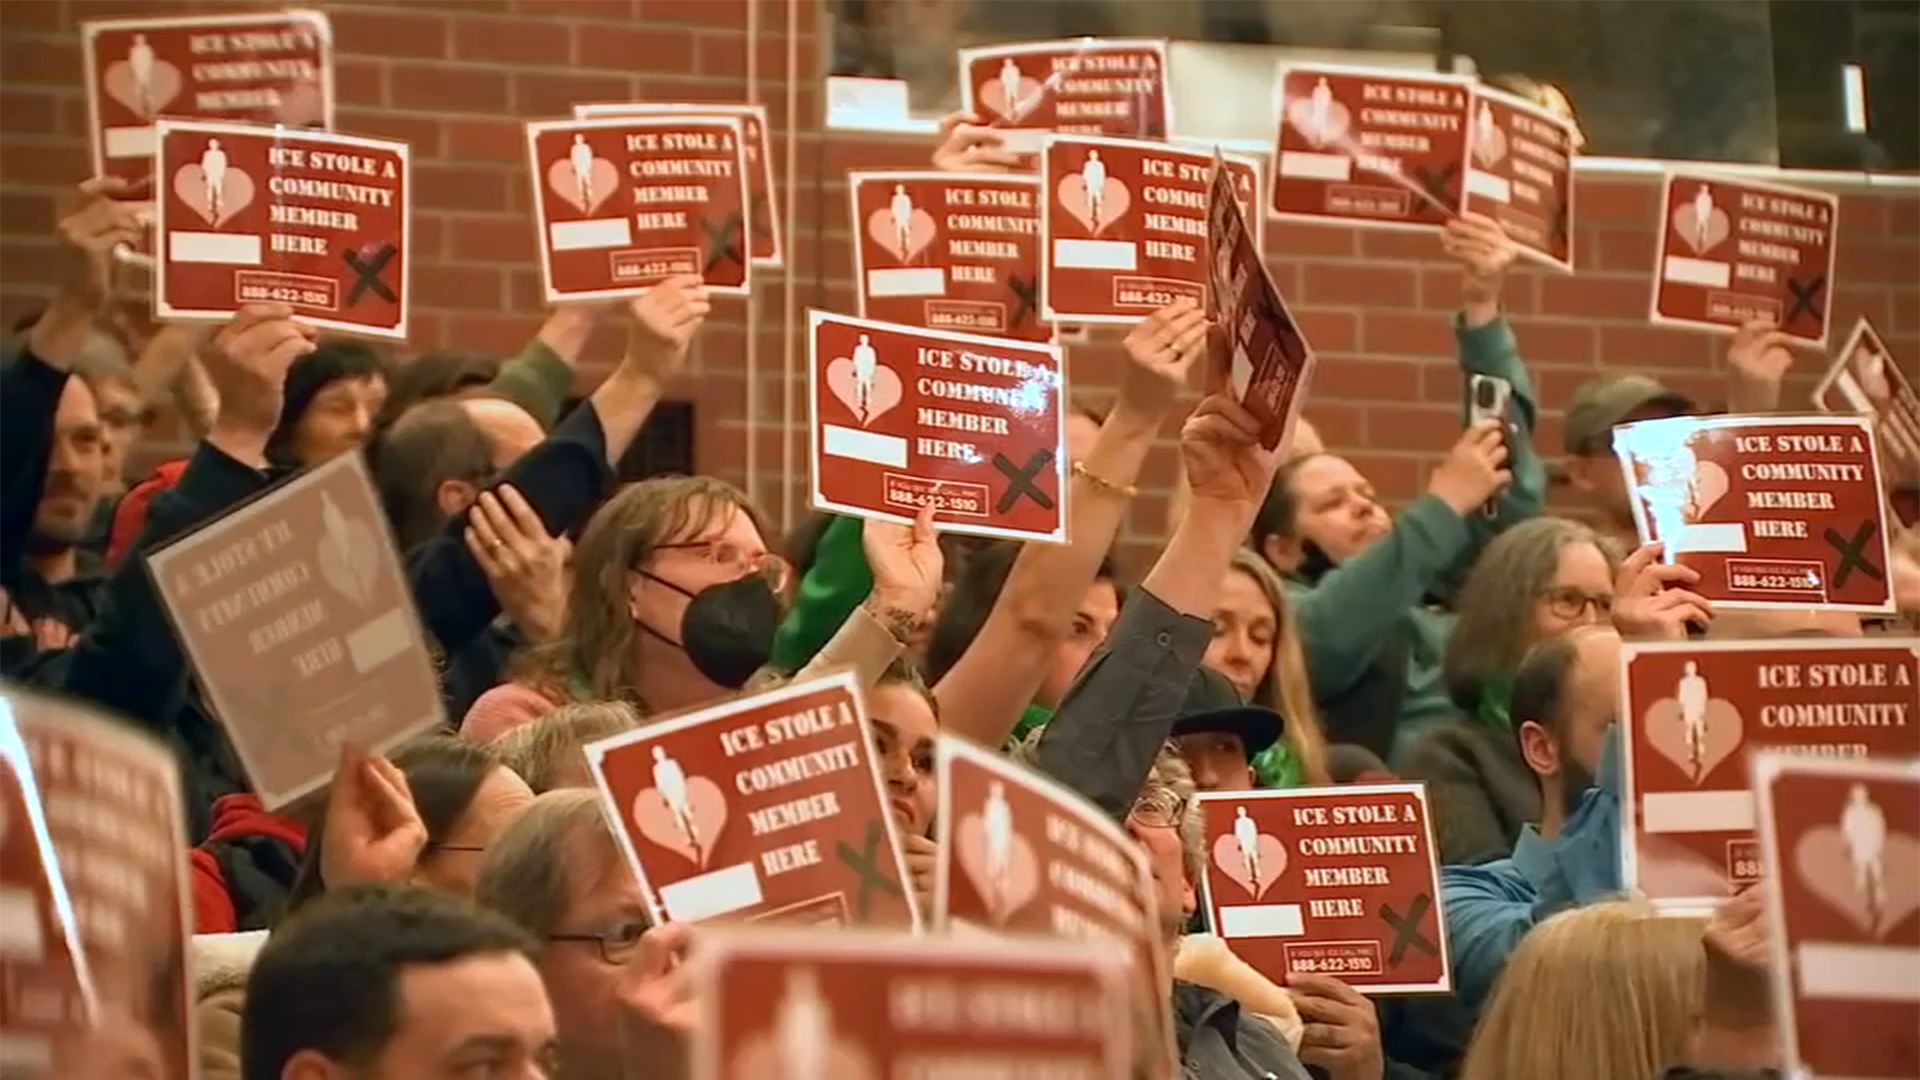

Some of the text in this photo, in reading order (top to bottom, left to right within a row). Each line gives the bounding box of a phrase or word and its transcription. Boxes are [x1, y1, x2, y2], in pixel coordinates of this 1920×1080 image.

[1363, 84, 1392, 100] ICE
[1361, 108, 1459, 131] COMMUNITY
[626, 133, 733, 152] ICE STOLE A
[268, 147, 397, 179] ICE STOLE A
[630, 160, 733, 178] COMMUNITY
[1142, 158, 1174, 177] ICE
[1238, 174, 1250, 190] A
[269, 176, 394, 207] COMMUNITY
[633, 186, 709, 204] MEMBER
[945, 188, 1031, 207] ICE STOLE
[270, 205, 359, 231] MEMBER
[1741, 192, 1830, 223] ICE STOLE A
[637, 212, 687, 231] HERE
[947, 214, 1041, 235] COMMUNIT
[1144, 213, 1208, 237] MEMBE
[1739, 218, 1825, 246] COMMUNITY
[271, 233, 328, 256] HERE
[949, 239, 1019, 259] MEMBER
[1145, 240, 1196, 262] HERE
[1738, 239, 1800, 265] MEMBER
[951, 265, 996, 283] HERE
[918, 347, 954, 368] ICE
[917, 407, 1009, 435] MEMBER
[917, 437, 977, 462] HERE
[1736, 436, 1865, 453] ICE STOLE A
[1742, 463, 1864, 481] COMMUNITY
[1747, 491, 1835, 509] MEMBER
[1753, 520, 1809, 538] HERE
[1758, 664, 1911, 689] ICE STOLE A
[1761, 703, 1908, 728] COMMUNITY
[720, 702, 854, 757] ICE STOLE A
[735, 741, 860, 796] COMMUNITY
[747, 791, 841, 836] MEMBER
[1293, 804, 1417, 826] ICE STOLE A
[1299, 835, 1418, 856] COMMUNITY
[761, 839, 822, 877] HERE
[1304, 866, 1390, 887] MEMBER
[1309, 898, 1364, 917] HERE
[1292, 957, 1373, 971] 888-622-1510
